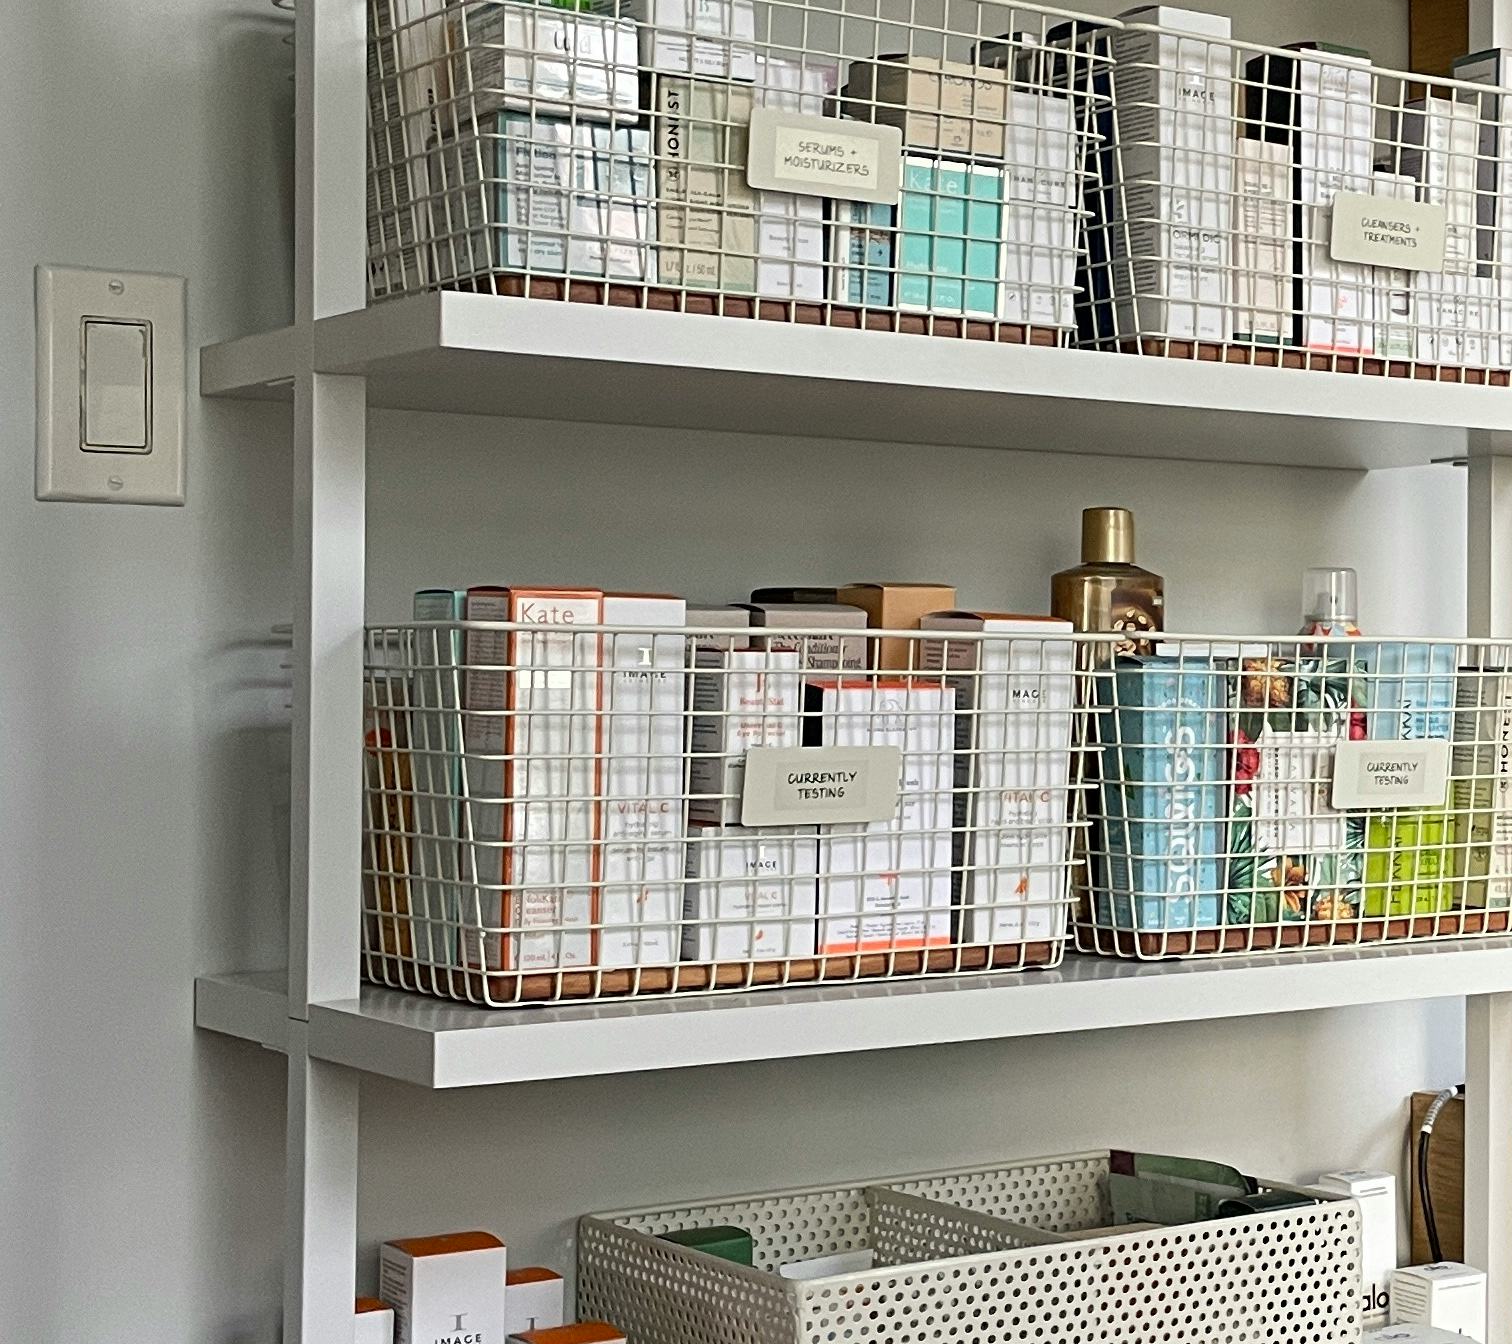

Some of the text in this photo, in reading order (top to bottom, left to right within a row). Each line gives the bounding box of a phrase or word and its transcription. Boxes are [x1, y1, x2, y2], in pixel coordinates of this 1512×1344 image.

[1178, 87, 1215, 102] IMAGE
[667, 90, 680, 158] HONST
[798, 141, 845, 157] SERUMS
[784, 155, 870, 177] MOISTURIZERS
[909, 170, 959, 193] Kae
[1013, 174, 1067, 188] HANCURE
[1361, 217, 1411, 234] CLEANSERS
[1172, 229, 1221, 243] ORMDIC
[1363, 231, 1418, 248] TREATMENTS
[521, 602, 575, 625] Kate
[1367, 761, 1418, 772] CURRENTLY
[788, 771, 857, 785] CURRENTLY
[1374, 775, 1409, 785] TESTING
[797, 788, 845, 799] TESTING
[617, 802, 670, 815] VITAL C
[1362, 1283, 1390, 1312] alo
